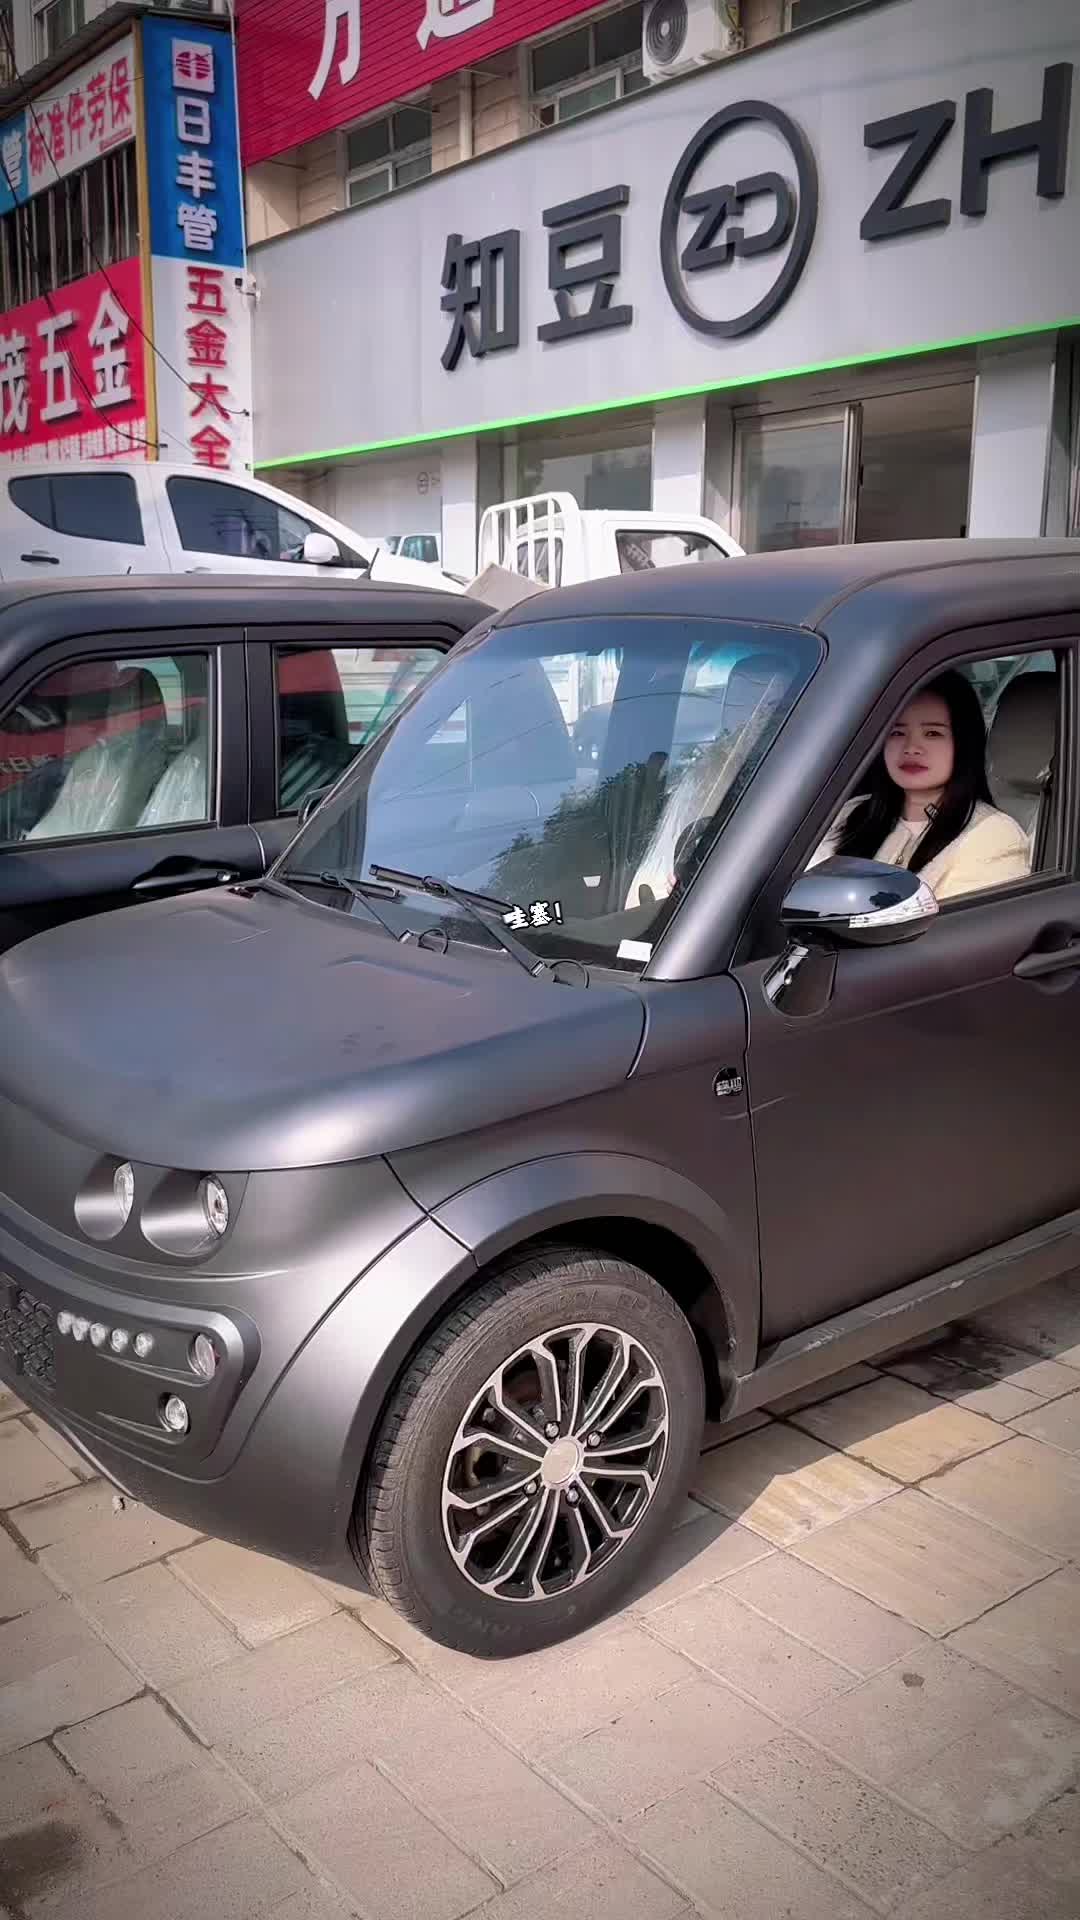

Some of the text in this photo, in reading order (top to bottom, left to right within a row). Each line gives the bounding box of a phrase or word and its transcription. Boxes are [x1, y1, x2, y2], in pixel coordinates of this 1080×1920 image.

[176, 95, 217, 251] 日丰管
[859, 61, 1074, 241] ZH
[185, 265, 231, 470] 五金大全
[440, 184, 633, 372] 知豆
